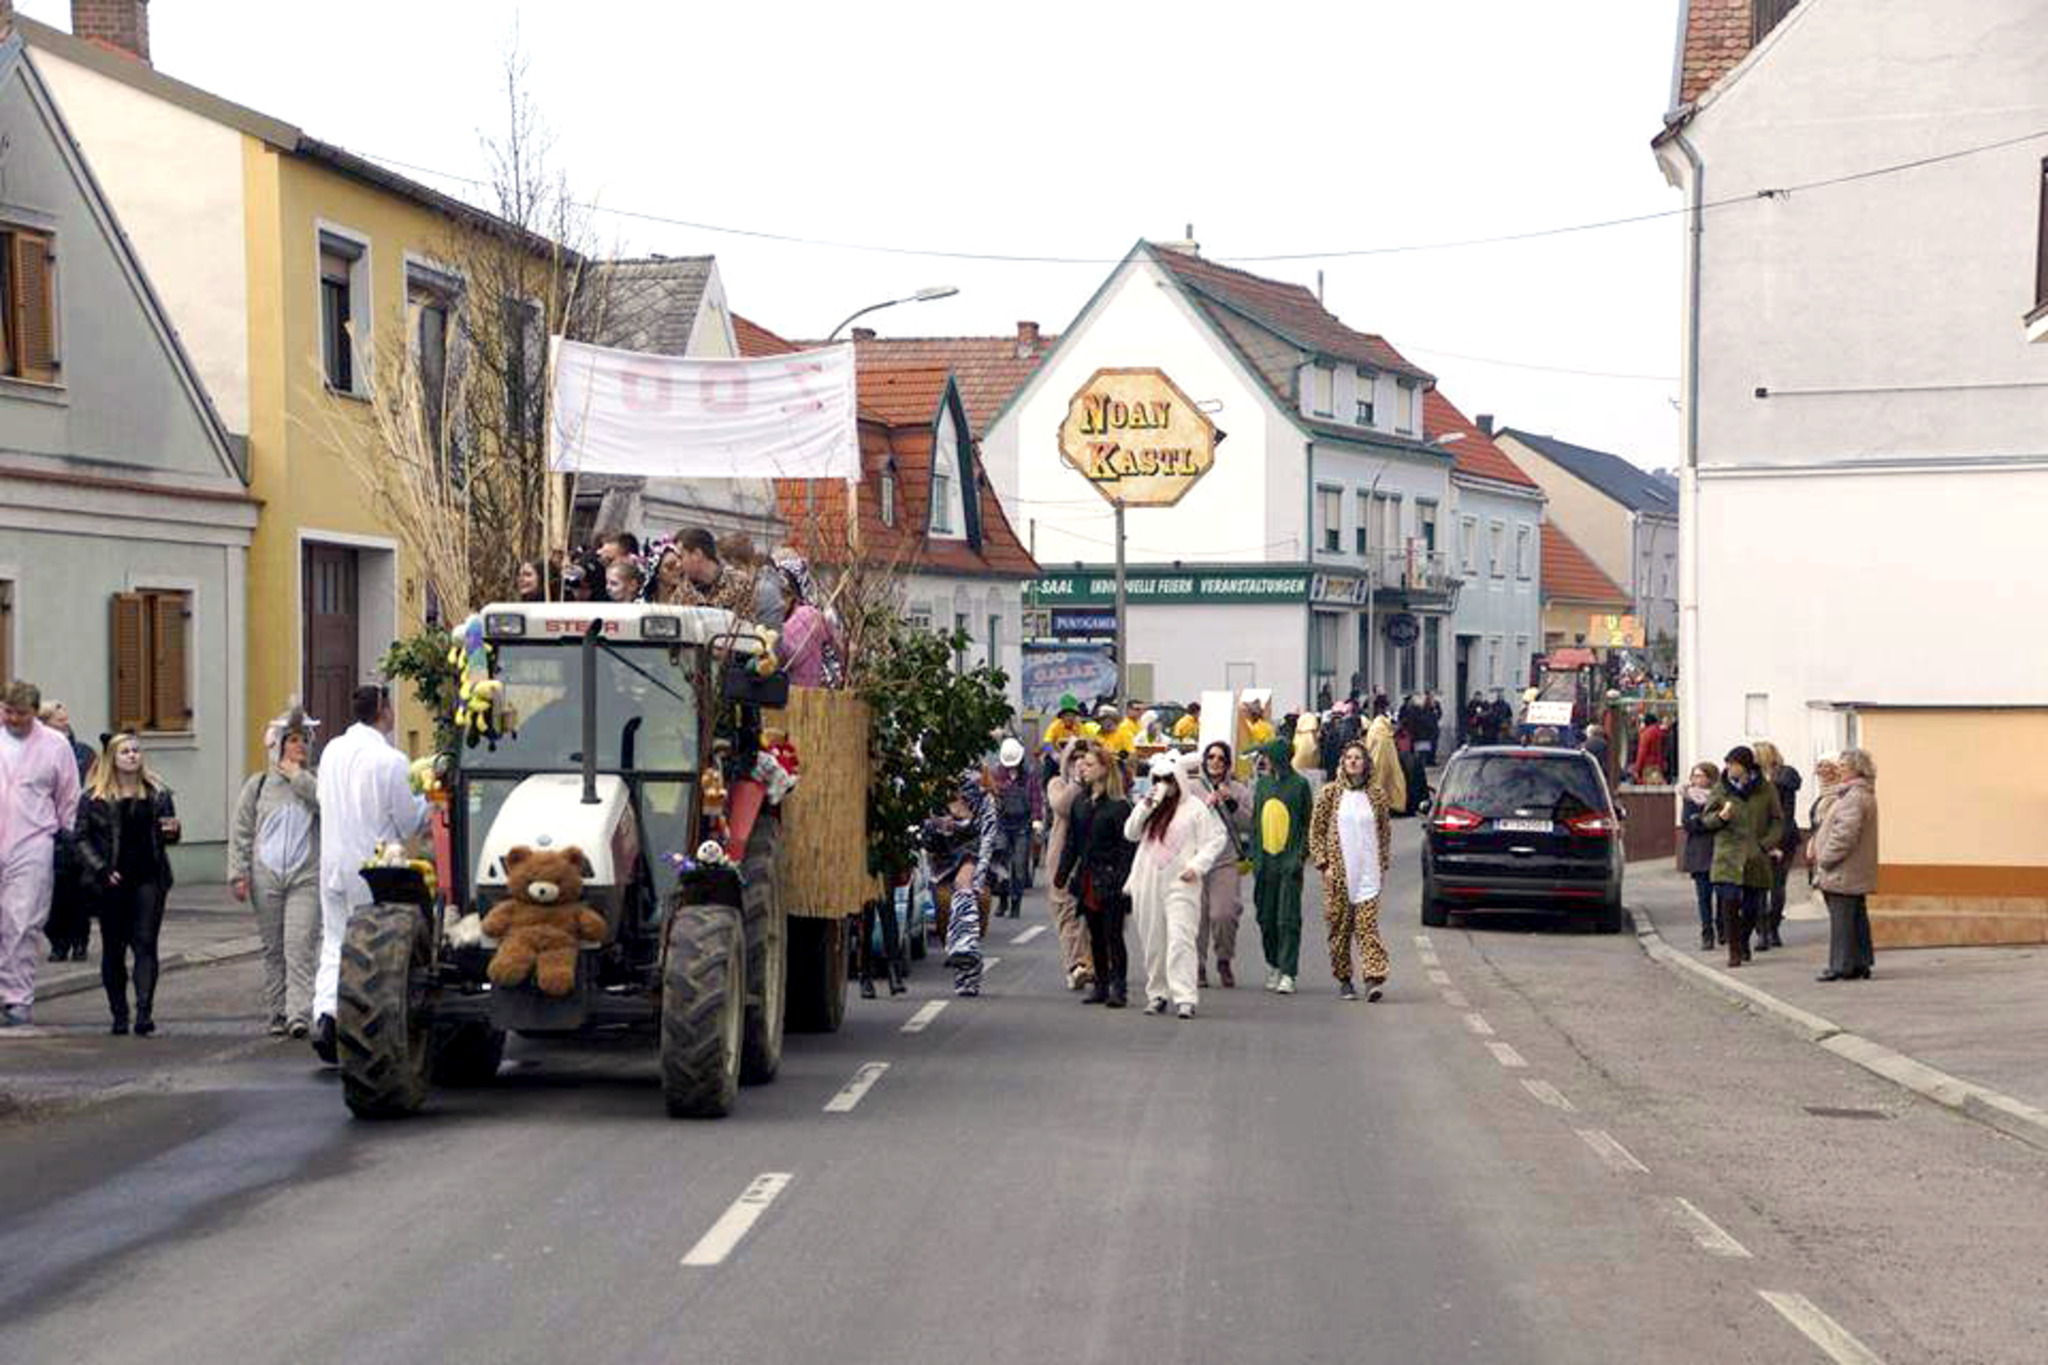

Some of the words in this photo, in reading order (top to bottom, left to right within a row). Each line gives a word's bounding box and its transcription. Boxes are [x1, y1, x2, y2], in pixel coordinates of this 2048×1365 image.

[1080, 393, 1171, 434] NOAN
[1200, 578, 1306, 594] VERANSTALTUNGEN
[545, 619, 619, 633] STER
